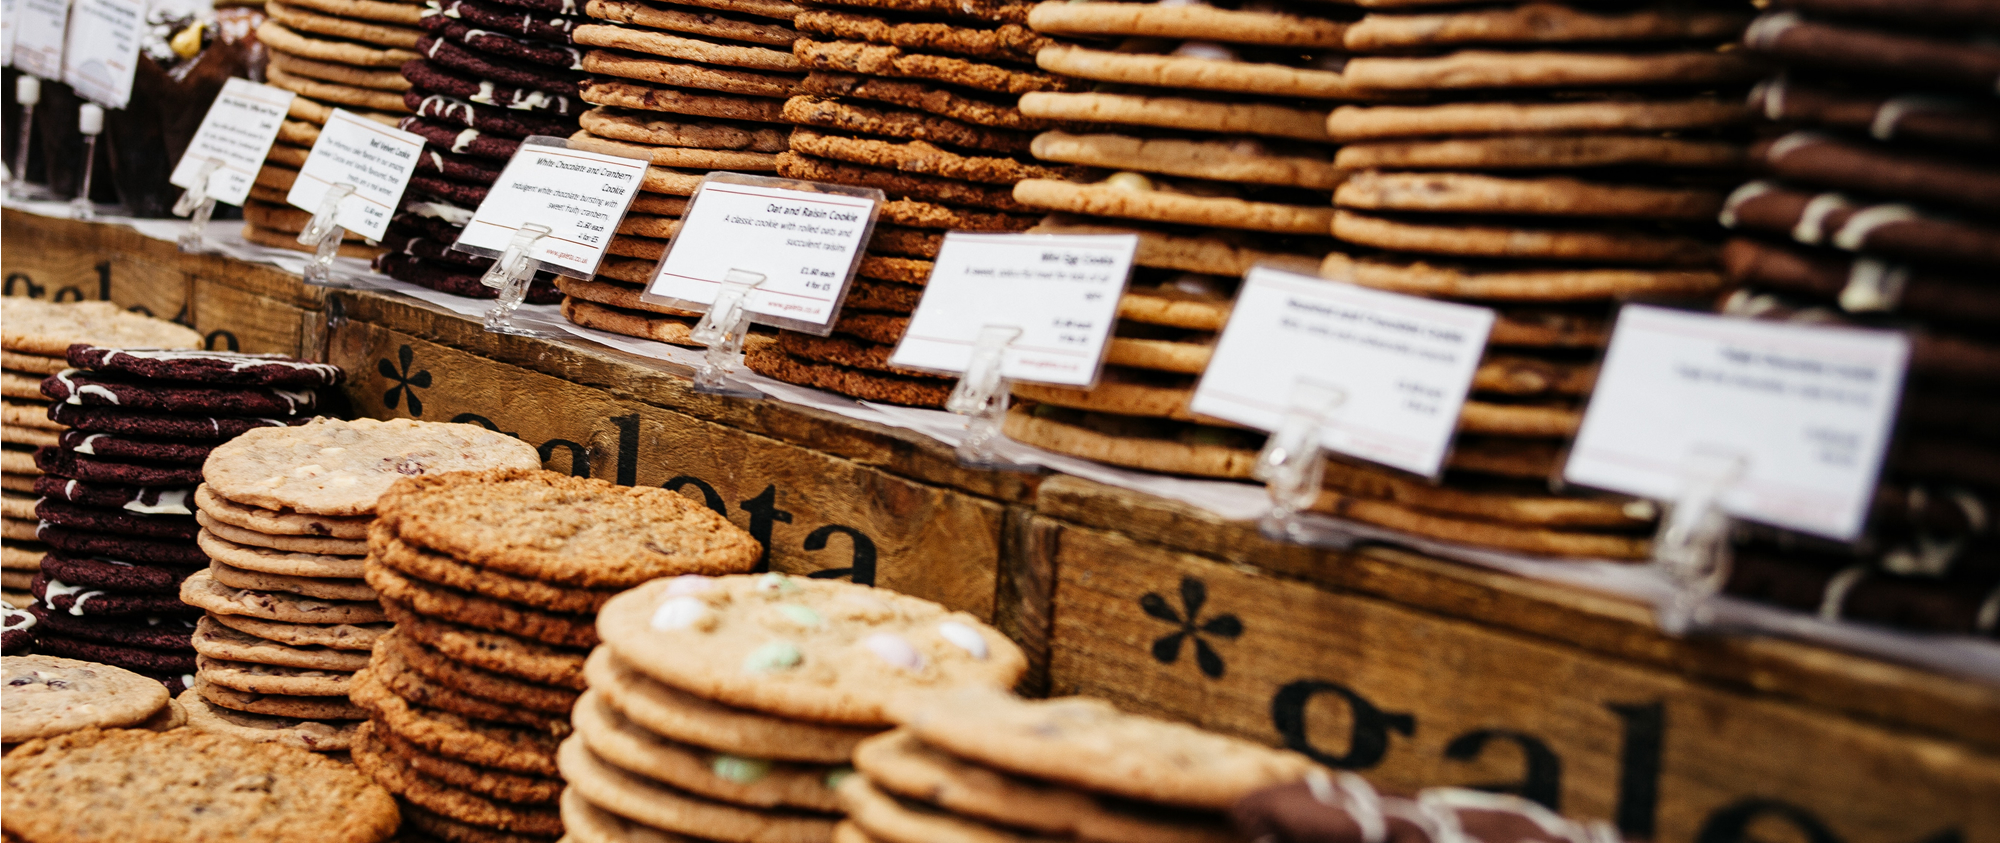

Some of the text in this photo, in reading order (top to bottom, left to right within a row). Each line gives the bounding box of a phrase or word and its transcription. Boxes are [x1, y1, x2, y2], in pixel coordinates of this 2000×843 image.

[370, 138, 411, 160] Red Velvet Cookie
[537, 157, 634, 183] White Chocolate and Cranberry
[512, 182, 618, 209] Indulgent white chocolate bursting with
[602, 183, 626, 195] Cookie
[547, 203, 565, 212] sweet
[566, 205, 580, 215] fruity
[767, 203, 858, 223] Oat and Raisin Cookie
[724, 214, 853, 238] A classic cookie with rolled oats and
[786, 238, 822, 249] succulent
[822, 283, 831, 291] £5
